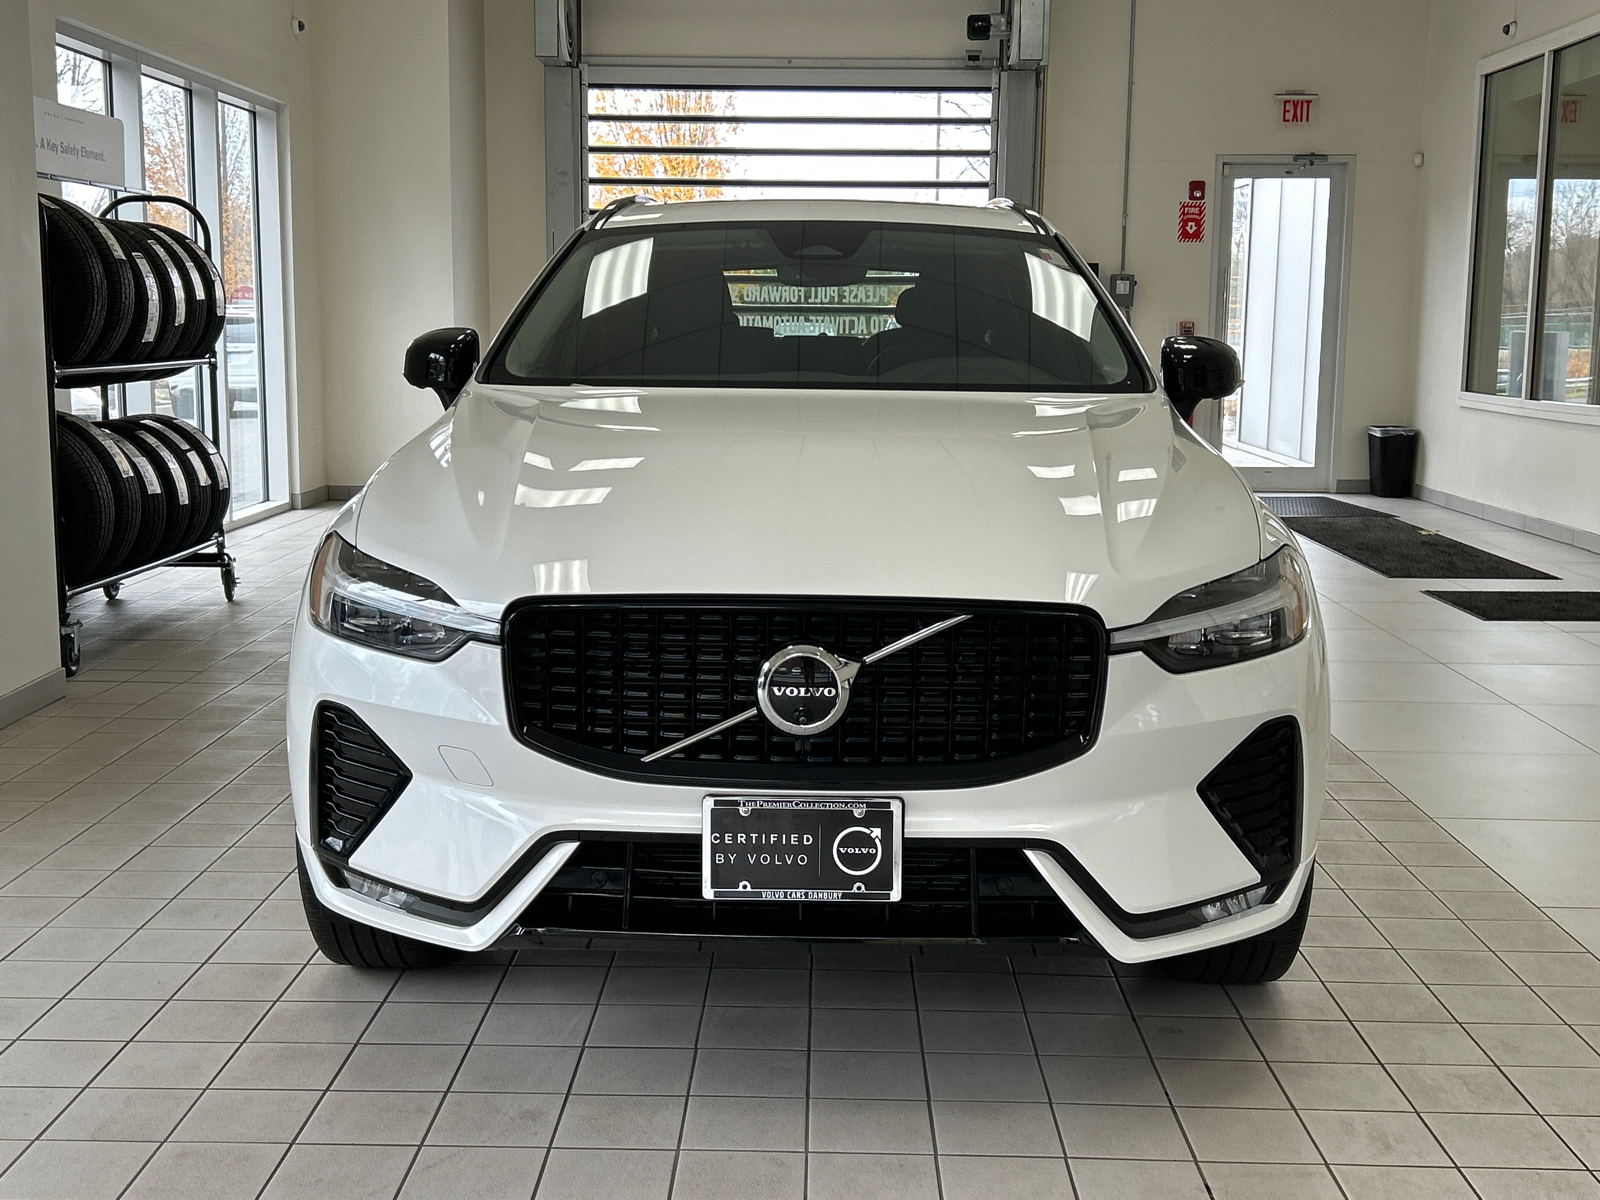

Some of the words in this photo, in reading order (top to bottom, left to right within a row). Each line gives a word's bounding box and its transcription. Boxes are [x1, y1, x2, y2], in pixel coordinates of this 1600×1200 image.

[1282, 99, 1312, 123] EXIT
[40, 137, 45, 150] A
[46, 138, 59, 156] Key
[59, 141, 80, 160] Safety
[80, 146, 106, 162] Element.
[771, 686, 837, 697] VOLVO
[711, 833, 813, 845] CERTIFIED
[715, 853, 737, 865] BY
[748, 853, 808, 865] VOLVO
[761, 890, 785, 899] VOLVO
[787, 891, 806, 900] CARS
[808, 891, 843, 900] DANBURY
